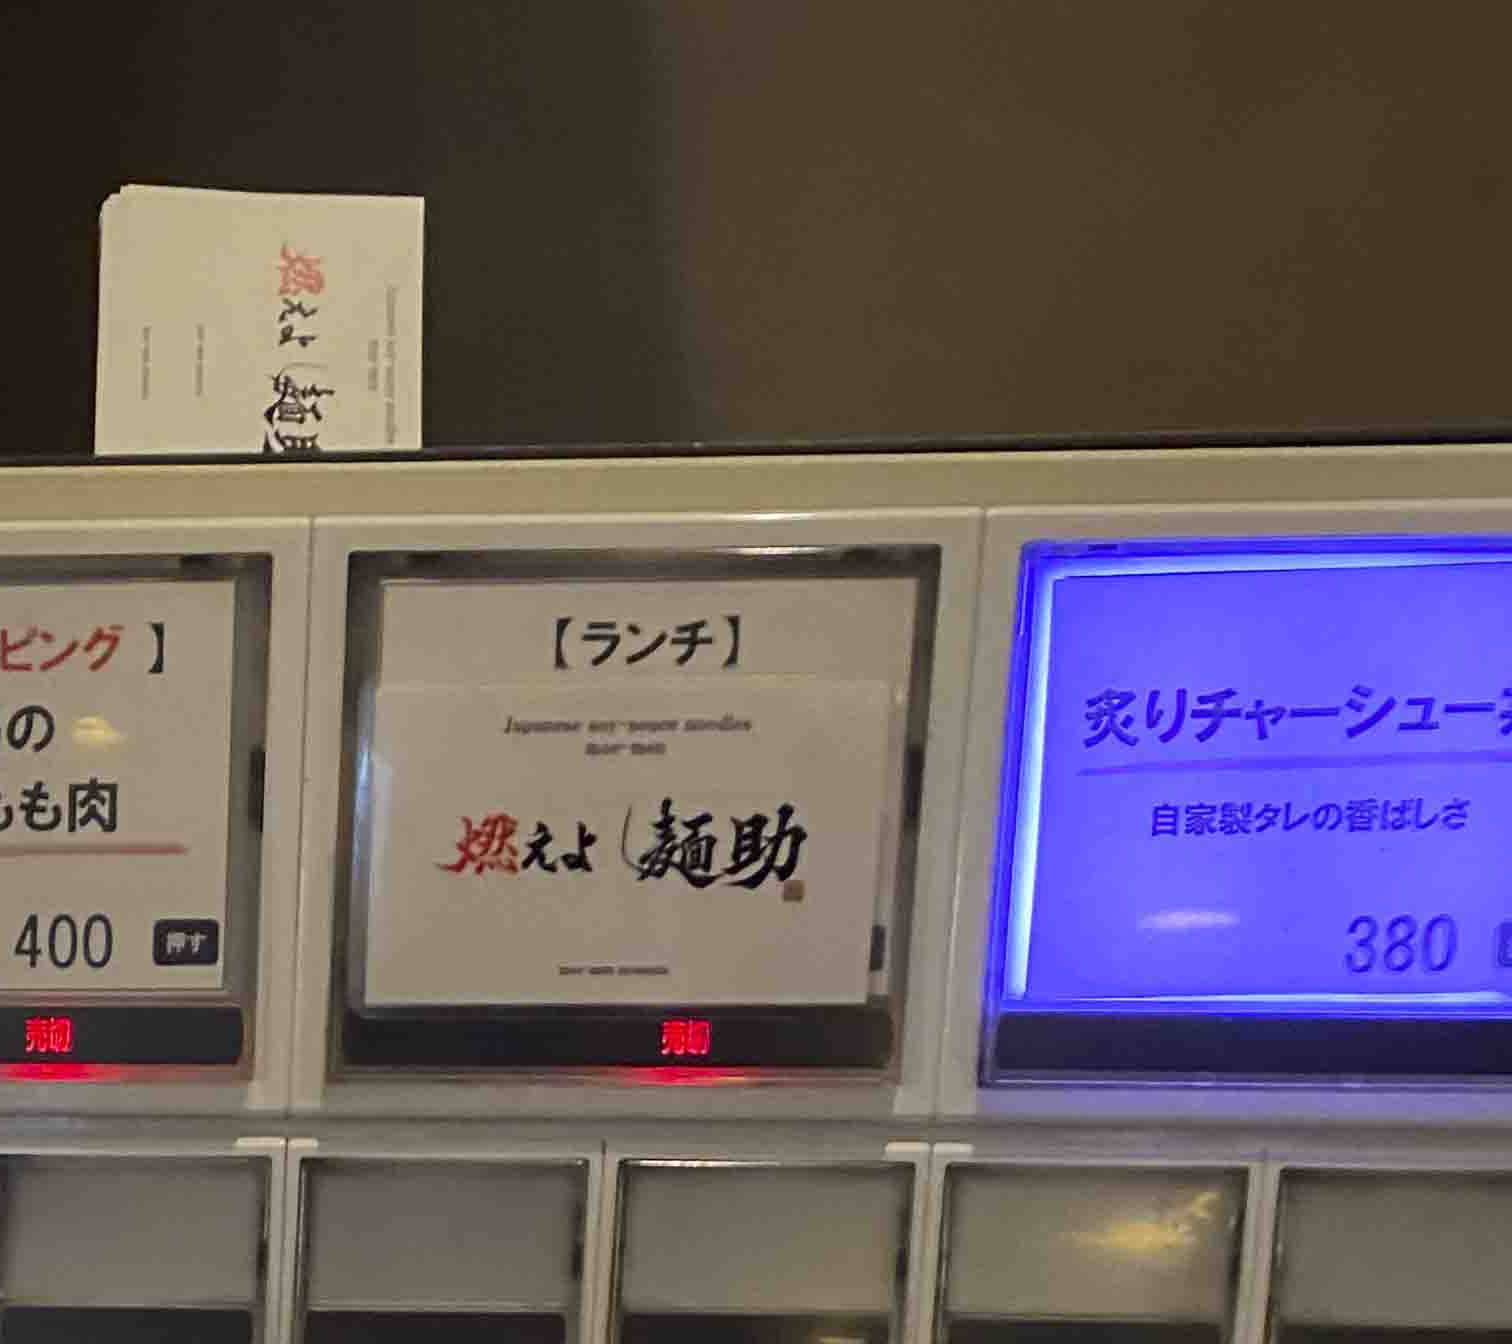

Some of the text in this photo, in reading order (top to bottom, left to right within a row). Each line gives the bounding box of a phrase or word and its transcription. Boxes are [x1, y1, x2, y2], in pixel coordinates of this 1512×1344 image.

[554, 615, 741, 669] 【ランチ】
[1150, 797, 1472, 837] 自家製タレの香ばしさ
[13, 913, 113, 969] 400
[165, 930, 207, 956] 押す
[1345, 914, 1458, 974] 380
[24, 1016, 73, 1053] 売切
